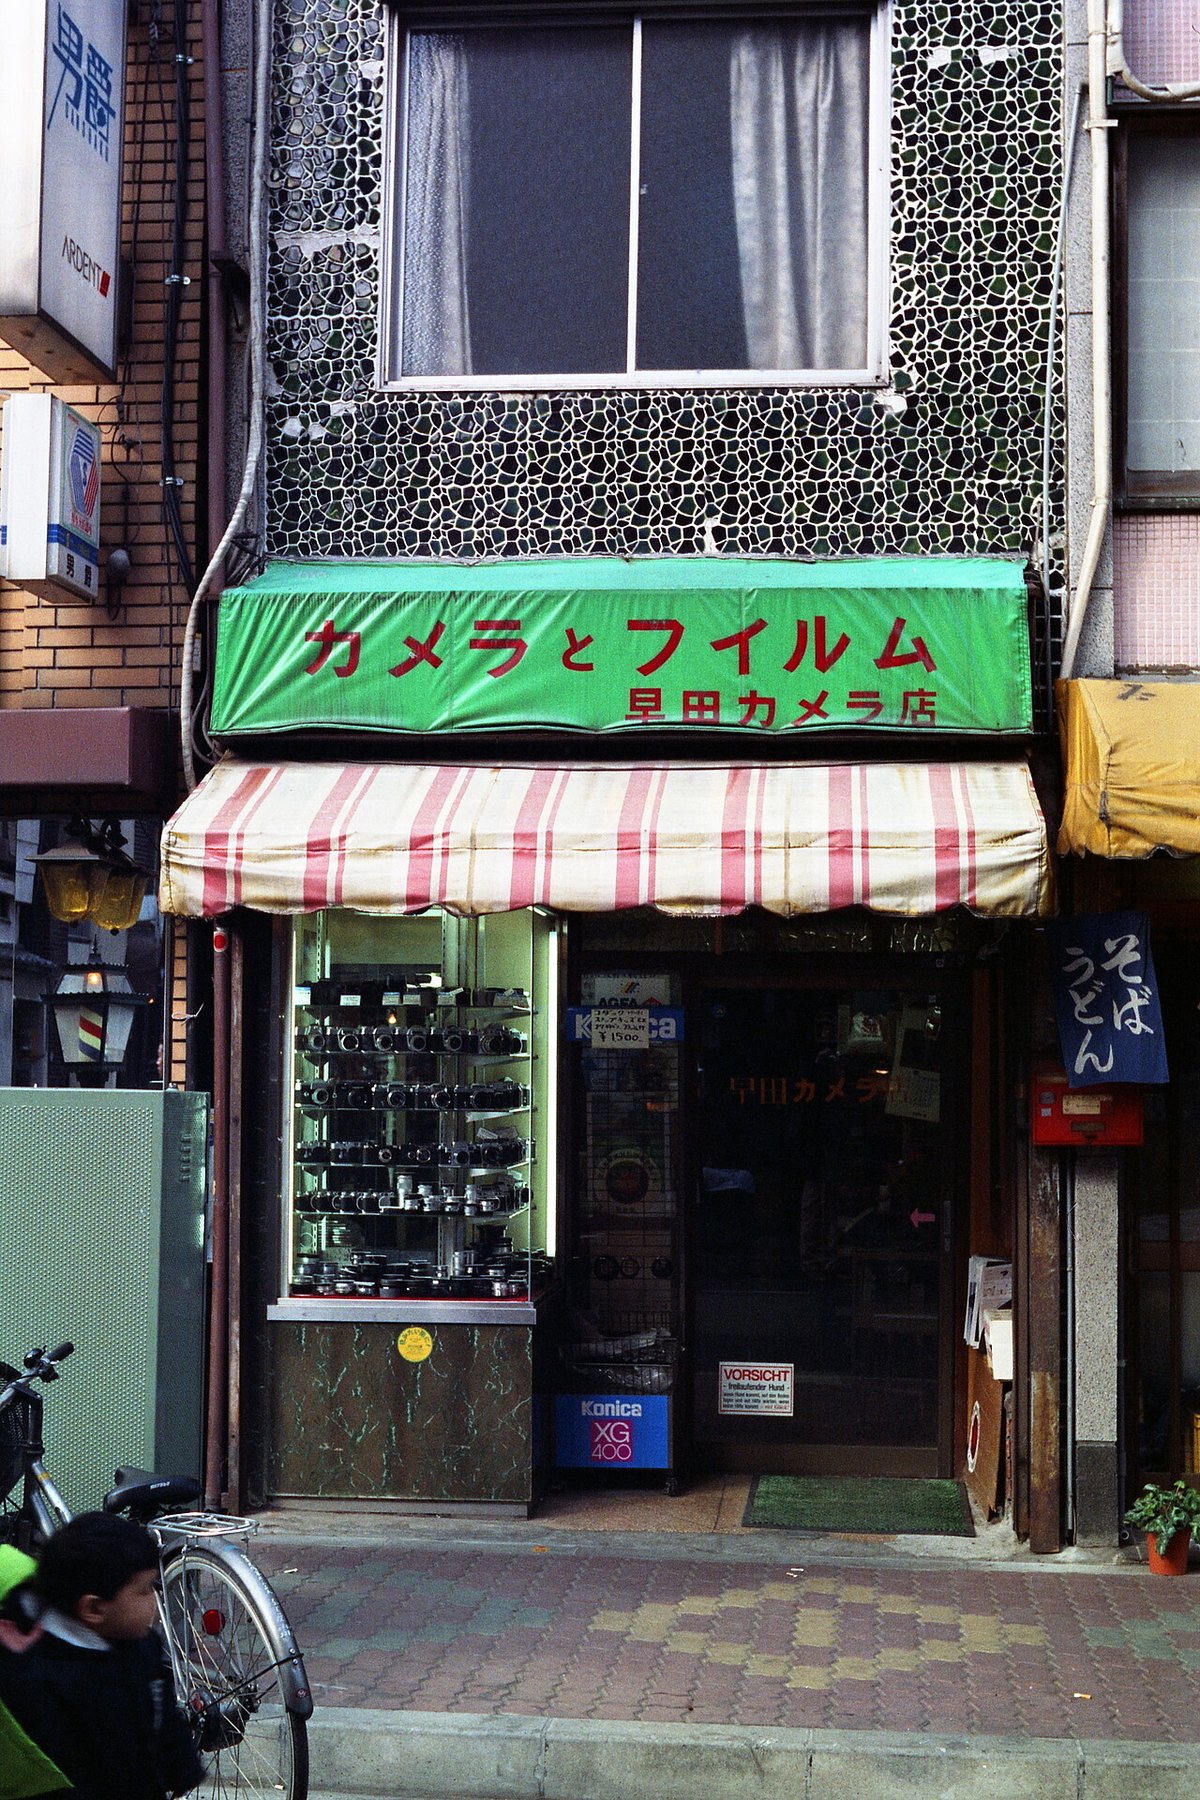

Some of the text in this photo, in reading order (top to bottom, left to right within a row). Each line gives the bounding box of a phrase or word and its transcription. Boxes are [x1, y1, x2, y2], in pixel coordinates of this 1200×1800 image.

[62, 235, 102, 291] ARDENT
[305, 616, 937, 678] カメラとフイルム
[625, 688, 937, 727] 早田カメラ店
[1100, 934, 1154, 1035] そば
[1062, 947, 1114, 1075] うどん
[723, 1368, 790, 1382] VORSICHT
[581, 1400, 642, 1417] Konica
[591, 1444, 632, 1460] 400
[594, 1422, 630, 1443] XG
